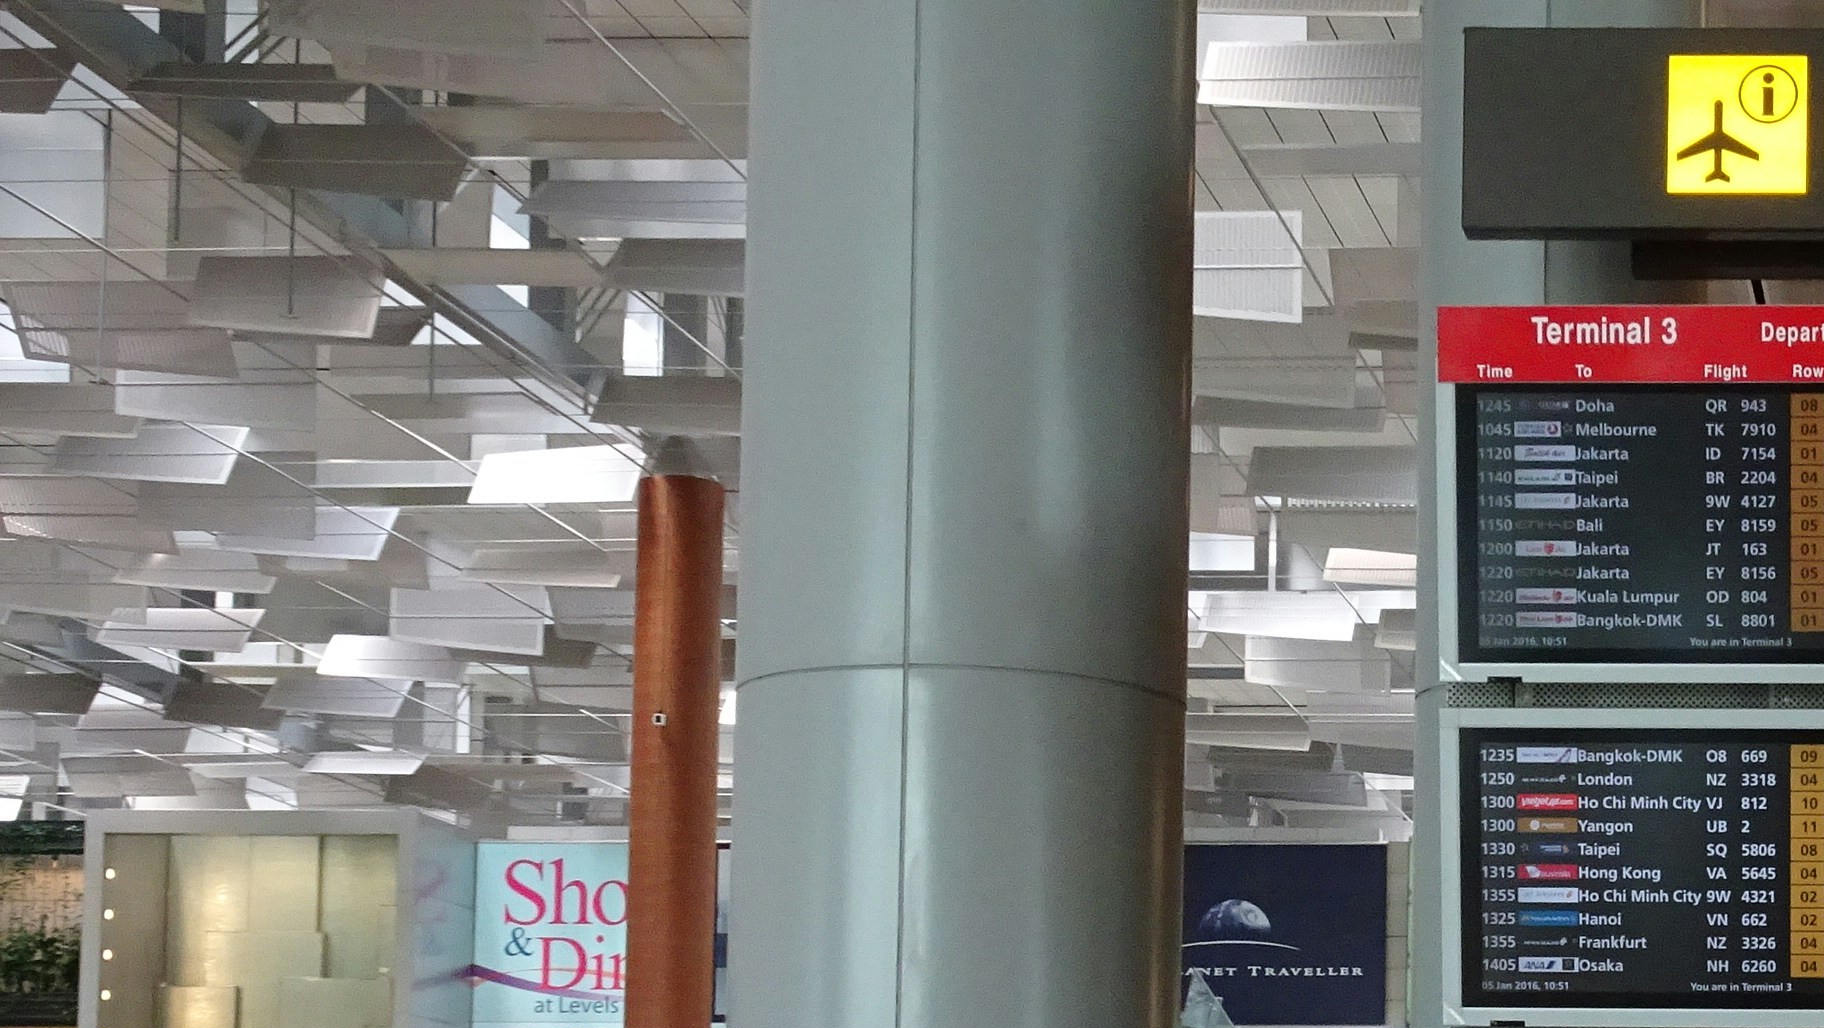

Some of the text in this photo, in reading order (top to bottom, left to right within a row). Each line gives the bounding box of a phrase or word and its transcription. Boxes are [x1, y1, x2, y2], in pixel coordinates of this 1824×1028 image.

[1532, 317, 1677, 344] Terminal 3
[1477, 364, 1512, 377] Time
[1576, 364, 1591, 377] To
[1705, 365, 1747, 381] Flight
[1793, 364, 1823, 377] Row
[1576, 423, 1656, 436] Melbourne
[1706, 424, 1724, 436] TK
[1742, 424, 1775, 436] 7910
[1576, 614, 1681, 629] Bangkok-DMK
[1481, 749, 1514, 761] 1235
[1578, 750, 1682, 764] Bangkok-DMK
[1742, 750, 1767, 762] 669
[1801, 750, 1817, 763] 09
[504, 858, 629, 926] Sho
[1580, 936, 1646, 948] Frankfurt
[505, 928, 625, 990] & Di
[1182, 966, 1362, 977] ANET TRAVELLER
[535, 998, 619, 1014] at Levels
